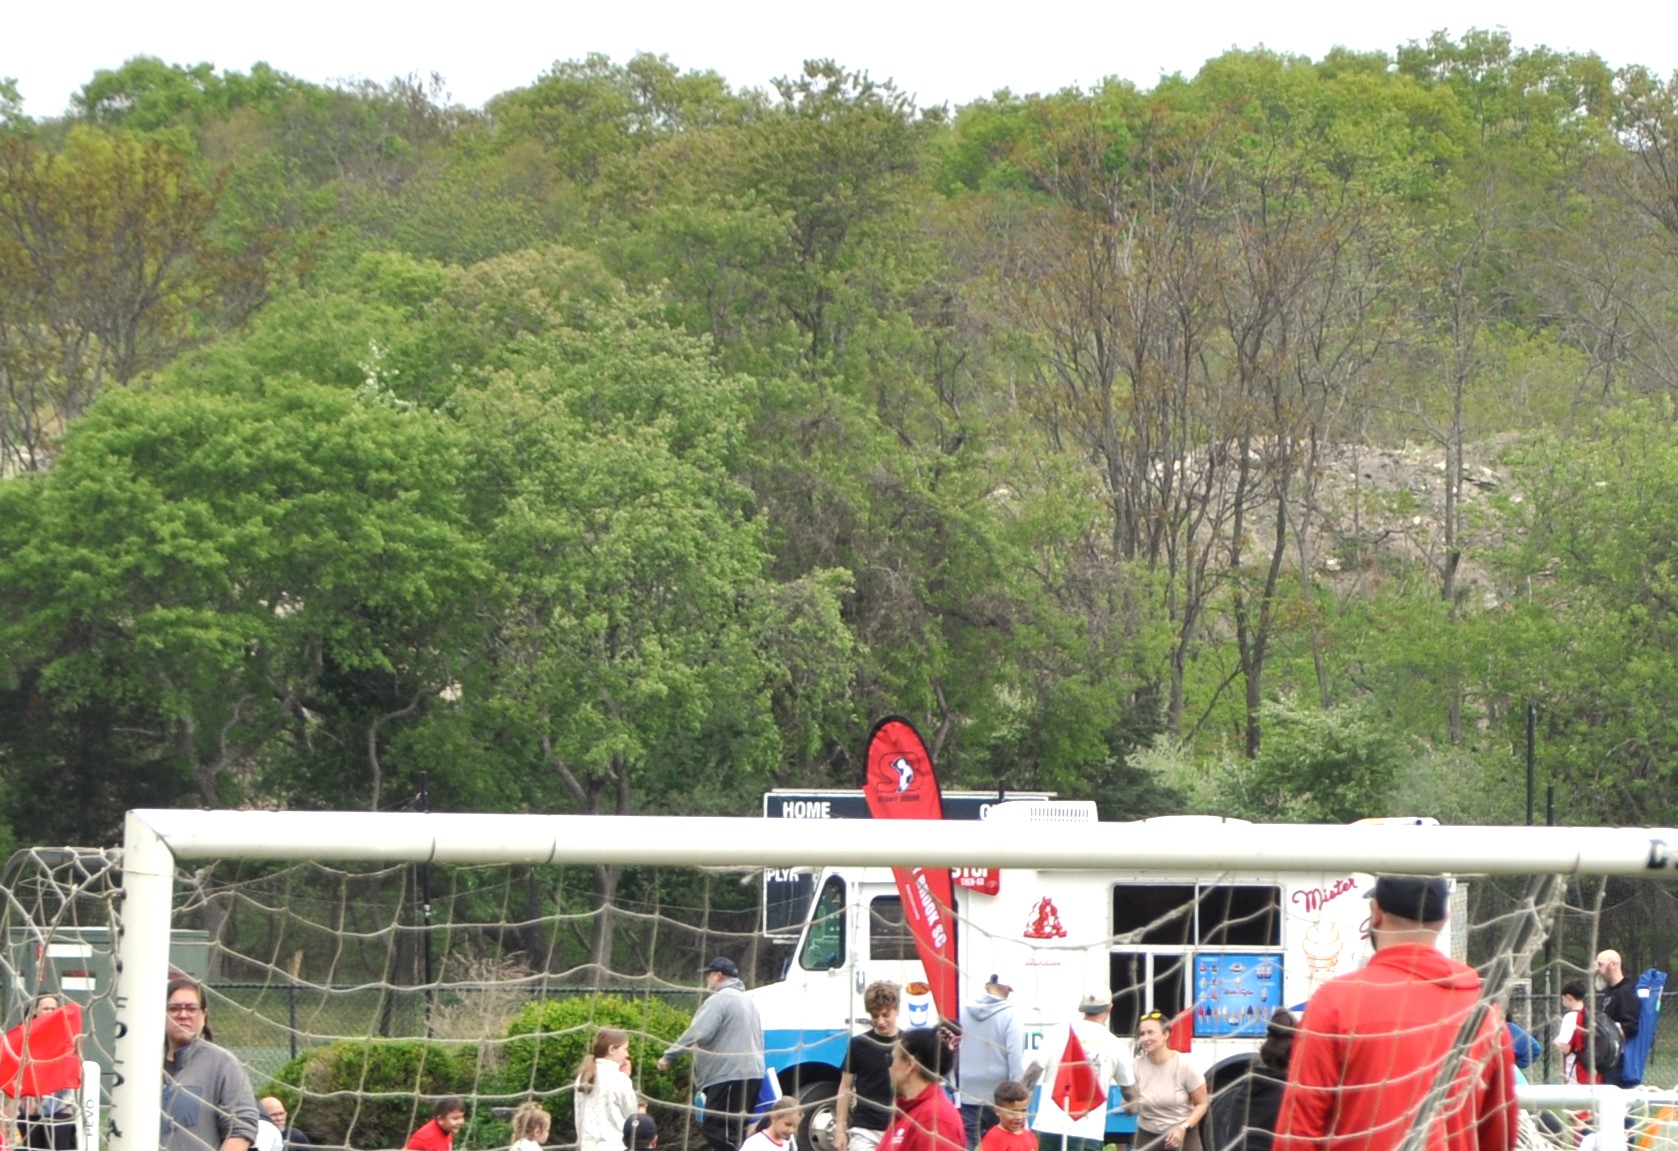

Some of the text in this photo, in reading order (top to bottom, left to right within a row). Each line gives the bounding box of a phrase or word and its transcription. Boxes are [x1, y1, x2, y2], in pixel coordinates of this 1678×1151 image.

[783, 801, 831, 818] HOME
[1291, 878, 1358, 913] Mister
[931, 924, 947, 948] SC
